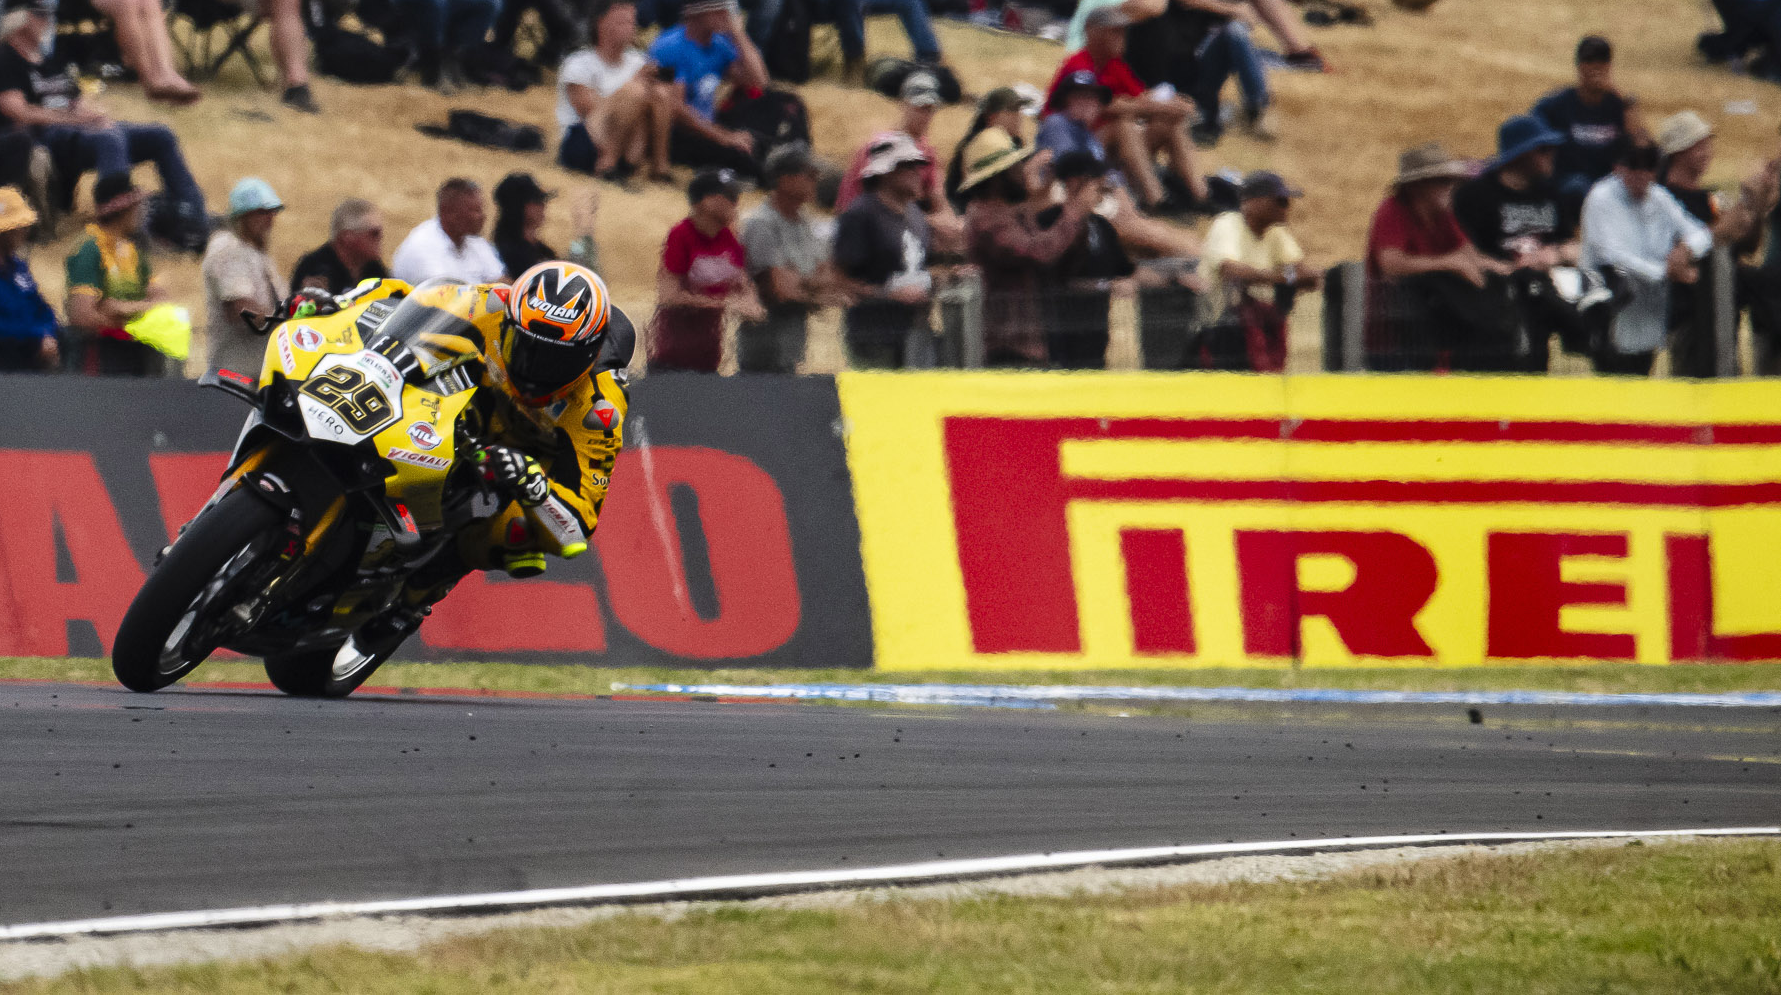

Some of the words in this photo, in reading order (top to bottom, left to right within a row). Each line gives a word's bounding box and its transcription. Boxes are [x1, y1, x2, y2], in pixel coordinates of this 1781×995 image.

[528, 295, 579, 324] NOLAN
[298, 364, 394, 435] 29
[307, 405, 344, 436] HERO
[386, 447, 451, 469] VIGNALI
[543, 503, 576, 534] IGNALI
